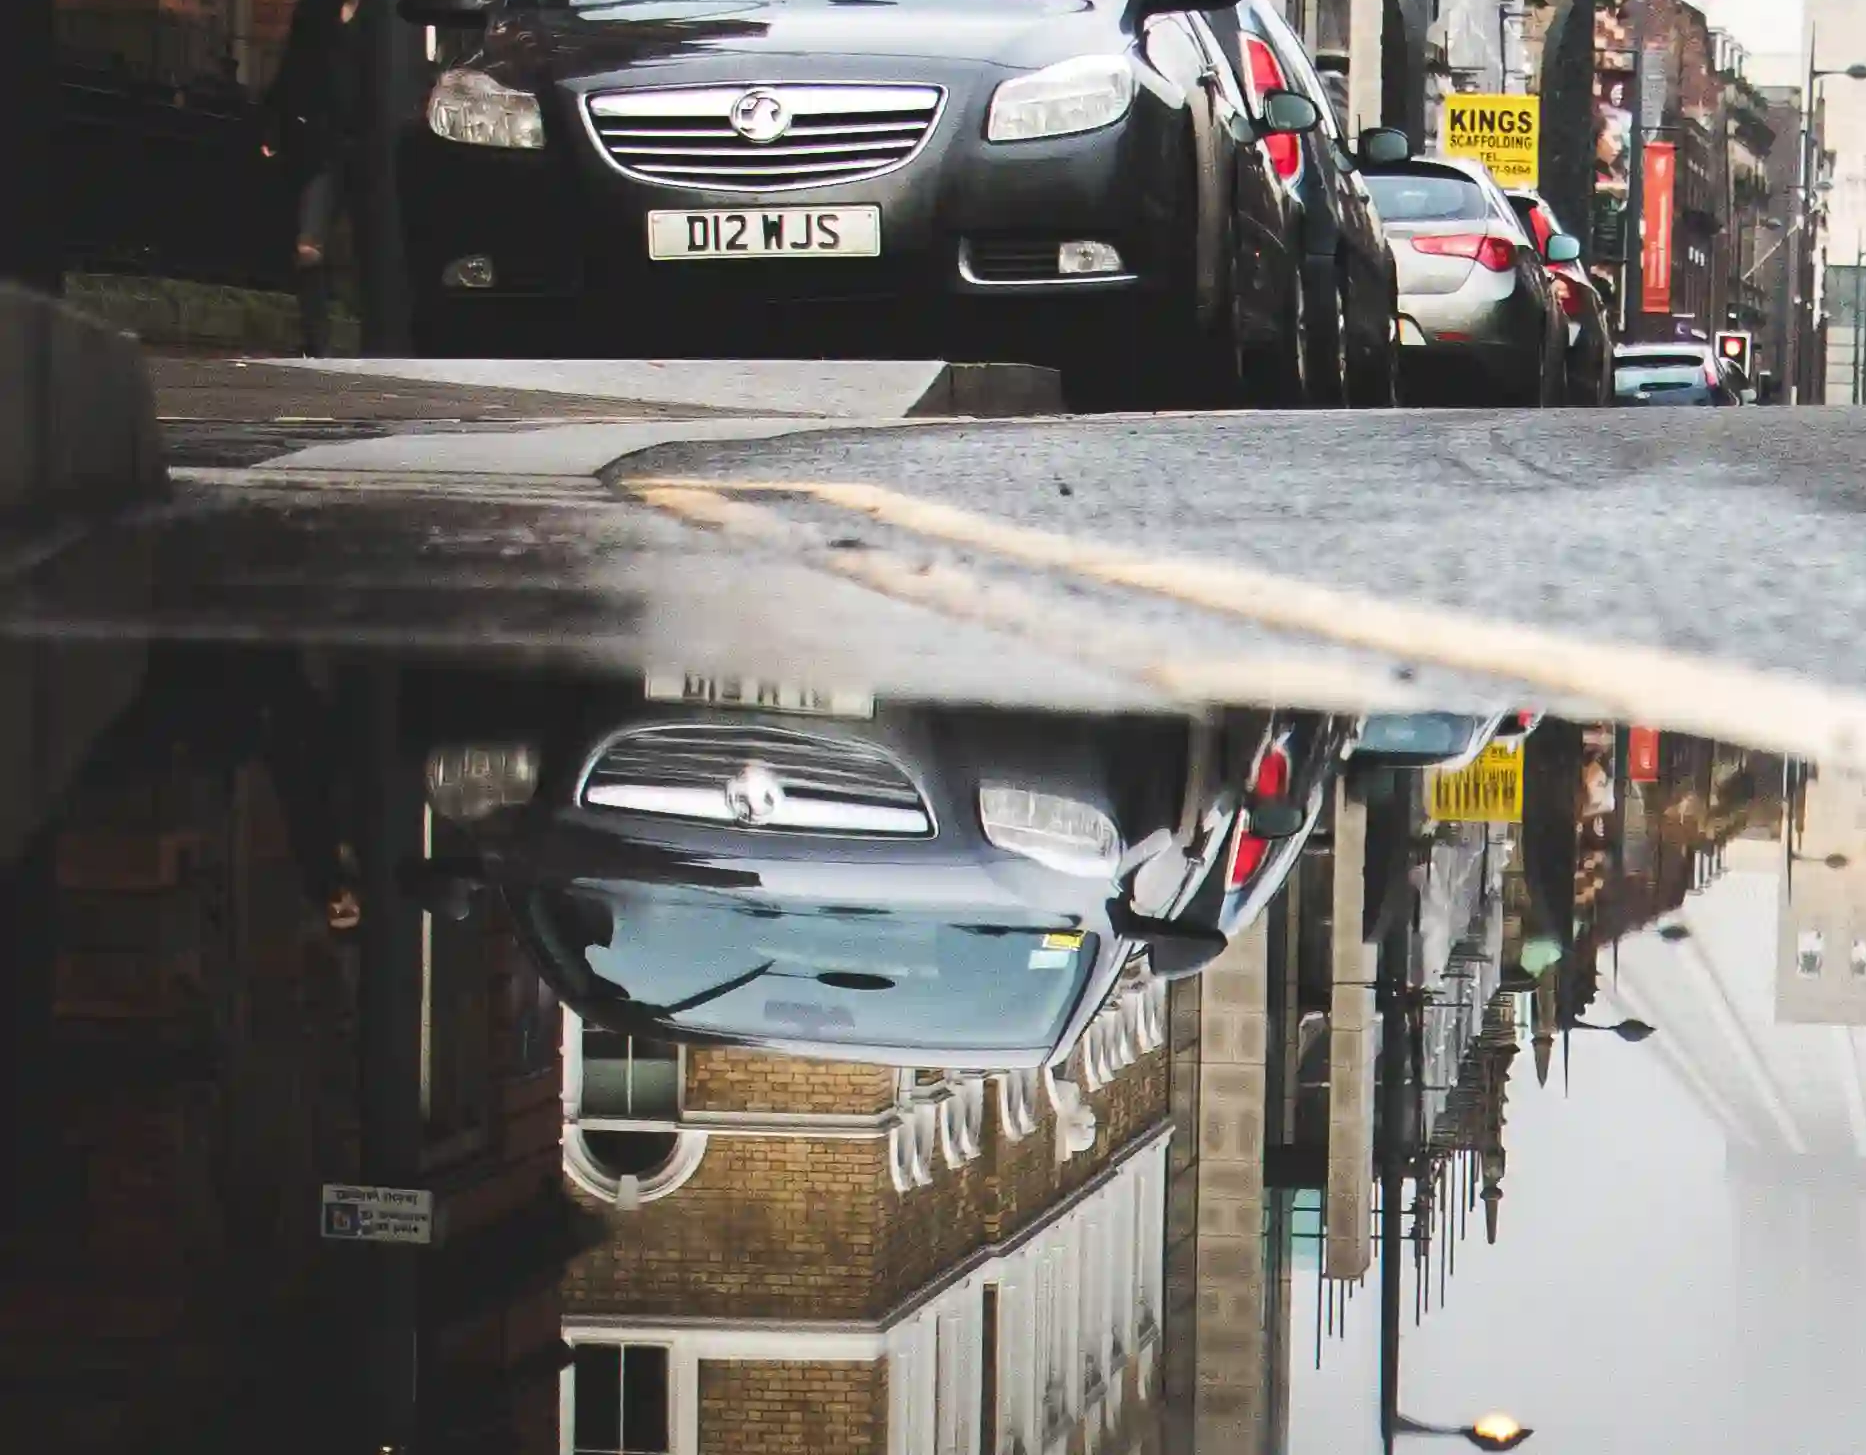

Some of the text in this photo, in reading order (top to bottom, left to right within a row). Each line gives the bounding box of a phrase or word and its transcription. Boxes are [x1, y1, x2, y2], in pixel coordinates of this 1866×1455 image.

[1450, 108, 1533, 134] KINGS
[1450, 135, 1533, 151] SCAFFOLDING
[687, 213, 840, 252] D12 WJS
